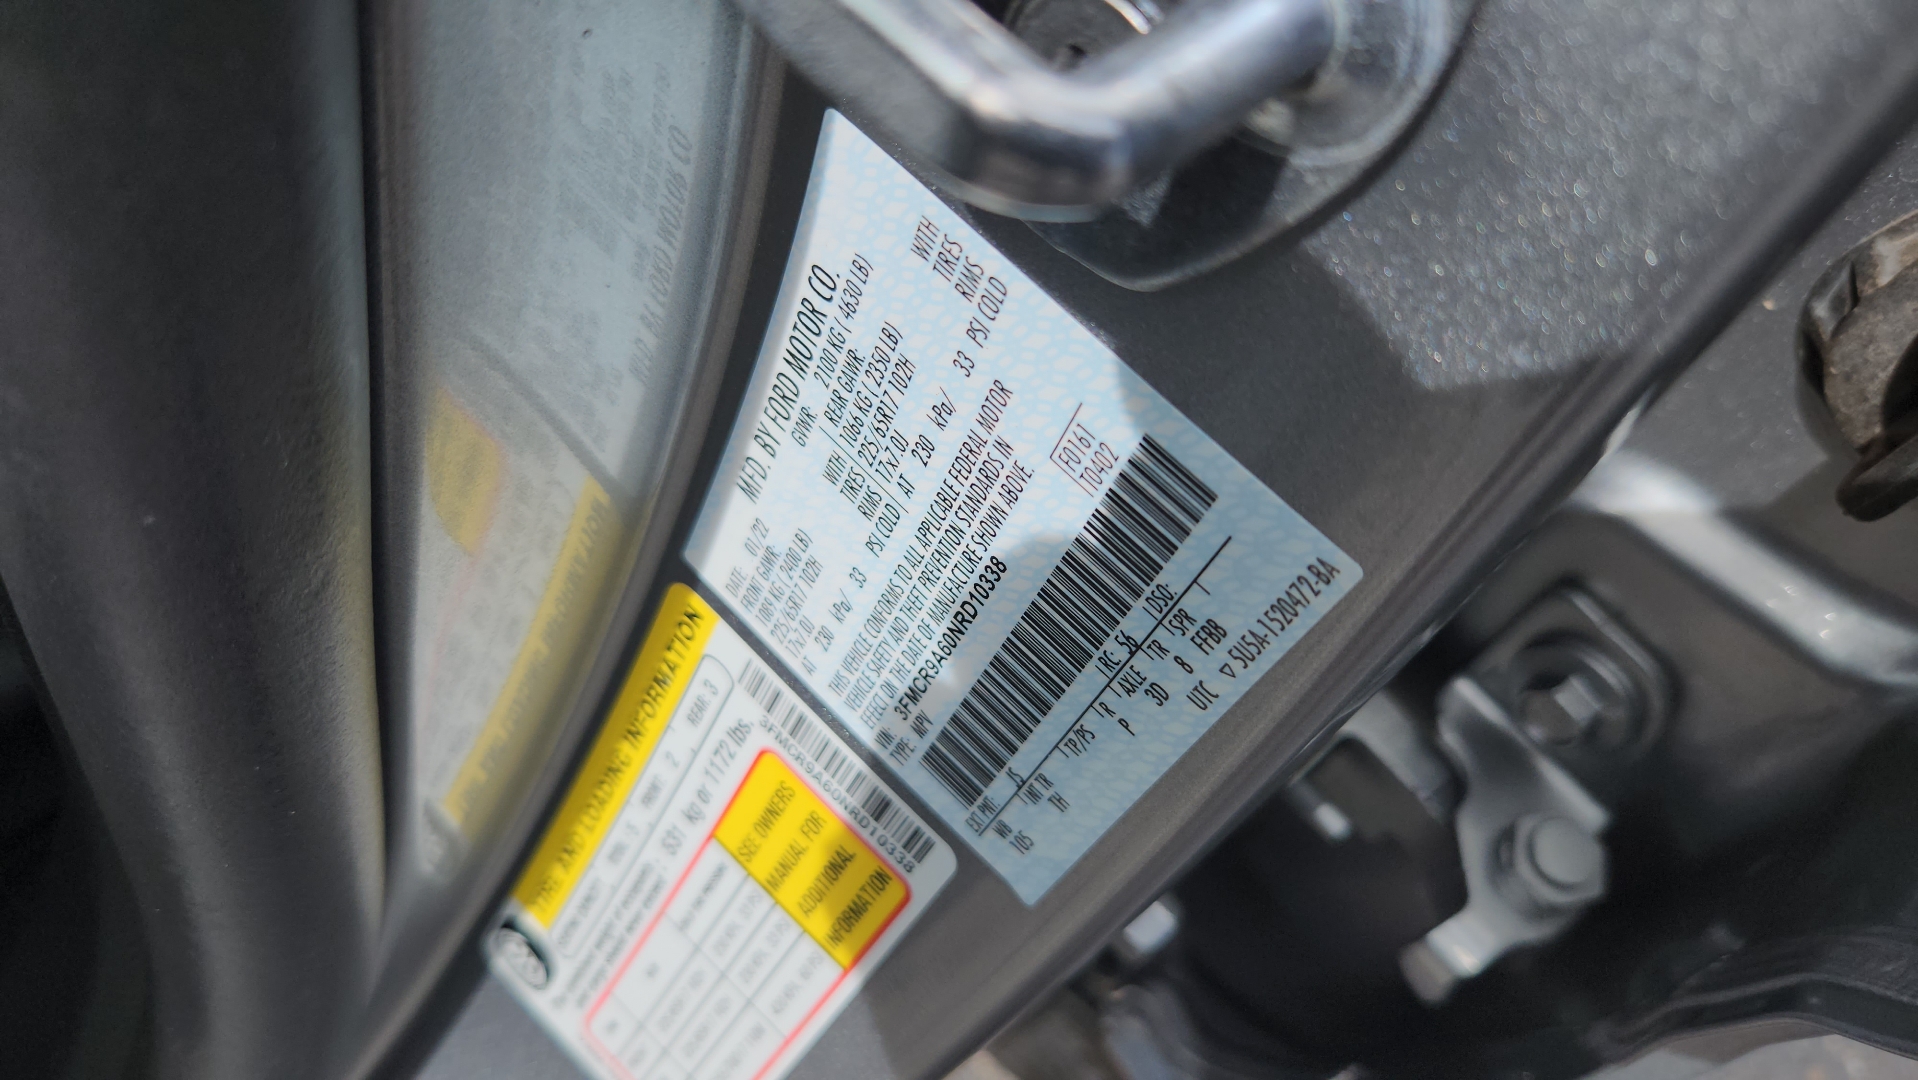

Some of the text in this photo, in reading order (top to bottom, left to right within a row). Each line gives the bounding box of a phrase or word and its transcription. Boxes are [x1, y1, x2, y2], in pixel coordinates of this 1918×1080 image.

[909, 214, 941, 262] WITH
[850, 252, 874, 285] LB)
[826, 324, 847, 354] KG
[856, 232, 964, 468] 225/65R17 102H TIRES
[879, 319, 905, 352] LB)
[734, 262, 842, 504] MFD. BY FORD MOTOR CO.
[812, 346, 841, 390] 2100
[822, 344, 866, 428] REAR GAWR:
[875, 255, 984, 484] 17x7.0J RIMS
[896, 274, 1009, 499] AT 230 kPa/ 33 PSI COLD
[791, 402, 819, 447] GVWR:
[851, 389, 873, 416] KG
[838, 409, 865, 448] 1066
[1057, 422, 1097, 472] F0161
[1078, 440, 1120, 491] T0402
[724, 516, 771, 598] DATE: 01/22
[753, 595, 779, 627] 1089
[767, 580, 786, 602] KG
[791, 527, 813, 553] LB)
[821, 449, 848, 486] WITH
[770, 466, 866, 644] 225/65R17 102H TIRES
[827, 378, 1014, 697] THIS VEHICLE CONFORMS TO ALL APPLICABLE FEDERAL MOTOR
[740, 541, 783, 613] FRONT GAWR:
[784, 484, 883, 659] 17x7.0J RIMS
[800, 502, 902, 676] AT 230 kPa/ 33 PSI COLD
[842, 434, 1015, 713] VEHICLE SAFETY AND THEFT PREVENTION STANDARDS IN
[858, 459, 1035, 730] EFFECT ON THE DATE OF MANUFACTURE SHOWN ABOVE.
[1145, 582, 1177, 614] DSO:
[1167, 607, 1198, 637] SPR
[1227, 555, 1340, 669] 5U5A-1520472-BA
[873, 554, 1009, 750] VIN: 3FMCR9A60NRD10338
[1096, 630, 1139, 673] RC: 56
[1146, 638, 1170, 660] TR
[1190, 616, 1228, 655] FFBB
[1116, 664, 1148, 697] AXLE
[1172, 654, 1195, 674] 8
[686, 678, 721, 728] REAR: 3
[1097, 701, 1117, 717] R
[1142, 680, 1171, 707] 3D
[1186, 679, 1219, 712] UTC
[574, 746, 633, 837] LOADING
[623, 603, 705, 750] INFORMATION
[724, 715, 755, 748] lbs.
[888, 709, 934, 766] TYPE: MPV
[1063, 723, 1096, 757] TP/PS
[1117, 717, 1135, 736] P
[703, 737, 739, 786] 1172
[680, 799, 707, 826] kg
[695, 782, 713, 804] or
[757, 713, 917, 873] 3FMCR9A60NRD10338
[964, 766, 1026, 833] EXT PNT: JS
[1022, 771, 1054, 805] INT TR
[1046, 790, 1071, 813] TH
[735, 832, 762, 864] SEE
[751, 778, 798, 839] OWNERS
[991, 818, 1013, 839] WB
[1008, 829, 1036, 855] 105
[764, 808, 827, 893] MANUAL FOR
[795, 843, 857, 918] ADDITIONAL
[821, 863, 894, 950] INFORMATION
